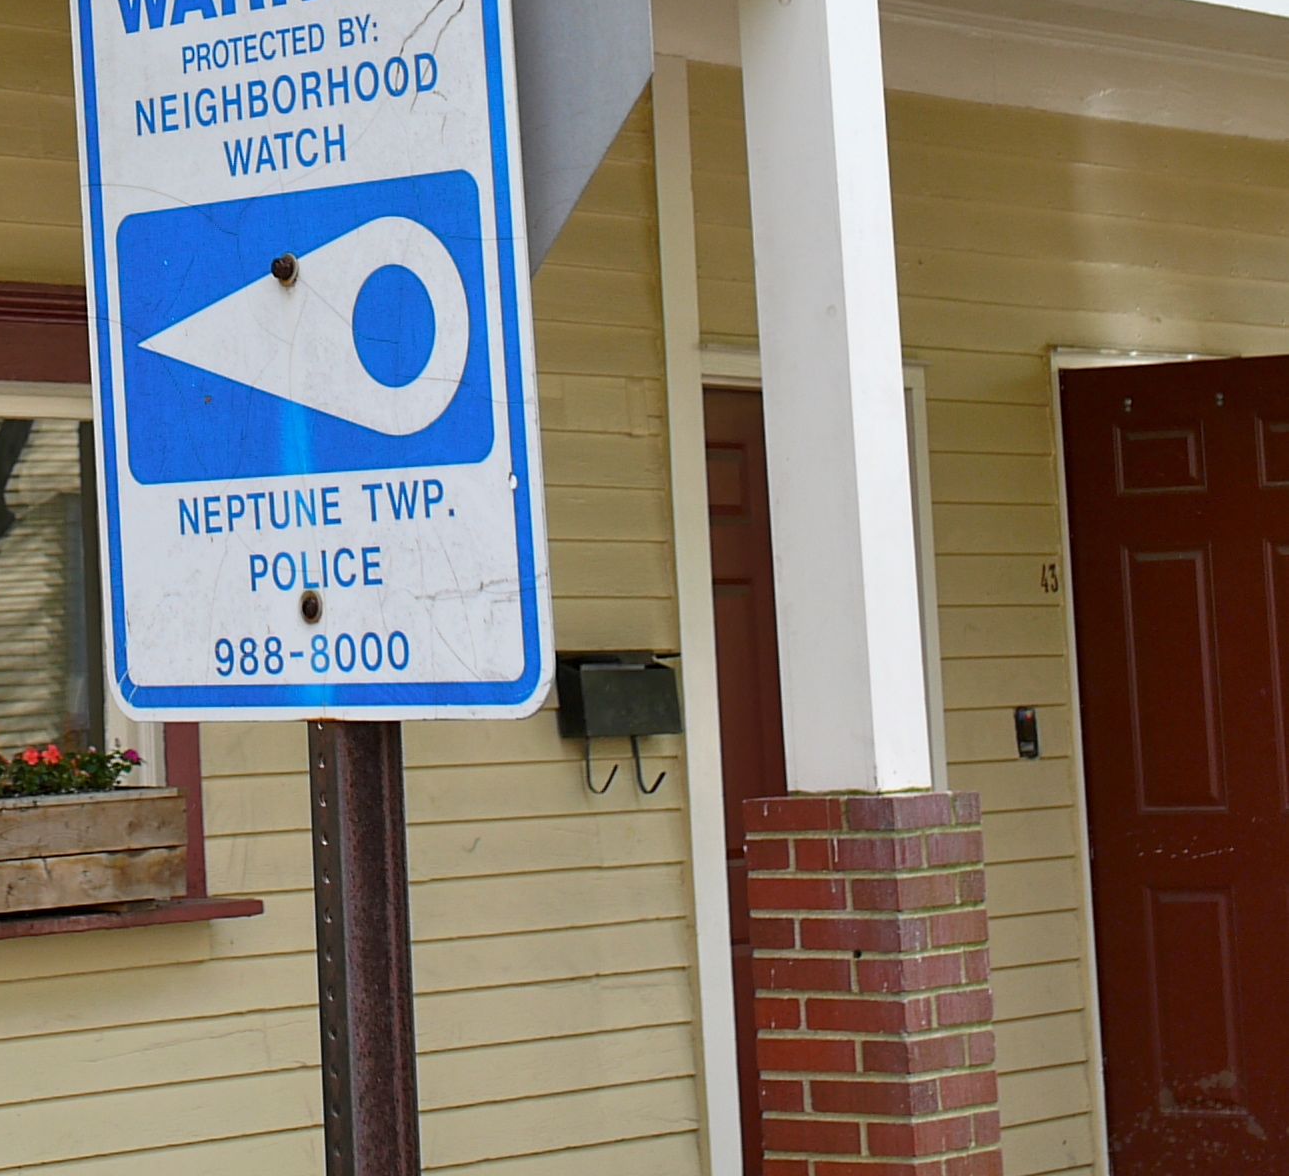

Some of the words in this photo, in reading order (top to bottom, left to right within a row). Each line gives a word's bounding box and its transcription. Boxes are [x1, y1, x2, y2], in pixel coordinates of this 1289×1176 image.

[182, 23, 325, 74] PROTECTED
[338, 13, 379, 48] BY:
[135, 52, 439, 136] NEIGHBORHOOD
[223, 124, 347, 177] WATCH
[178, 486, 341, 535] NEPTUNE
[362, 479, 456, 522] TWP.
[250, 546, 383, 591] POLICE
[1040, 563, 1058, 593] 43
[215, 630, 410, 677] 988-8000
